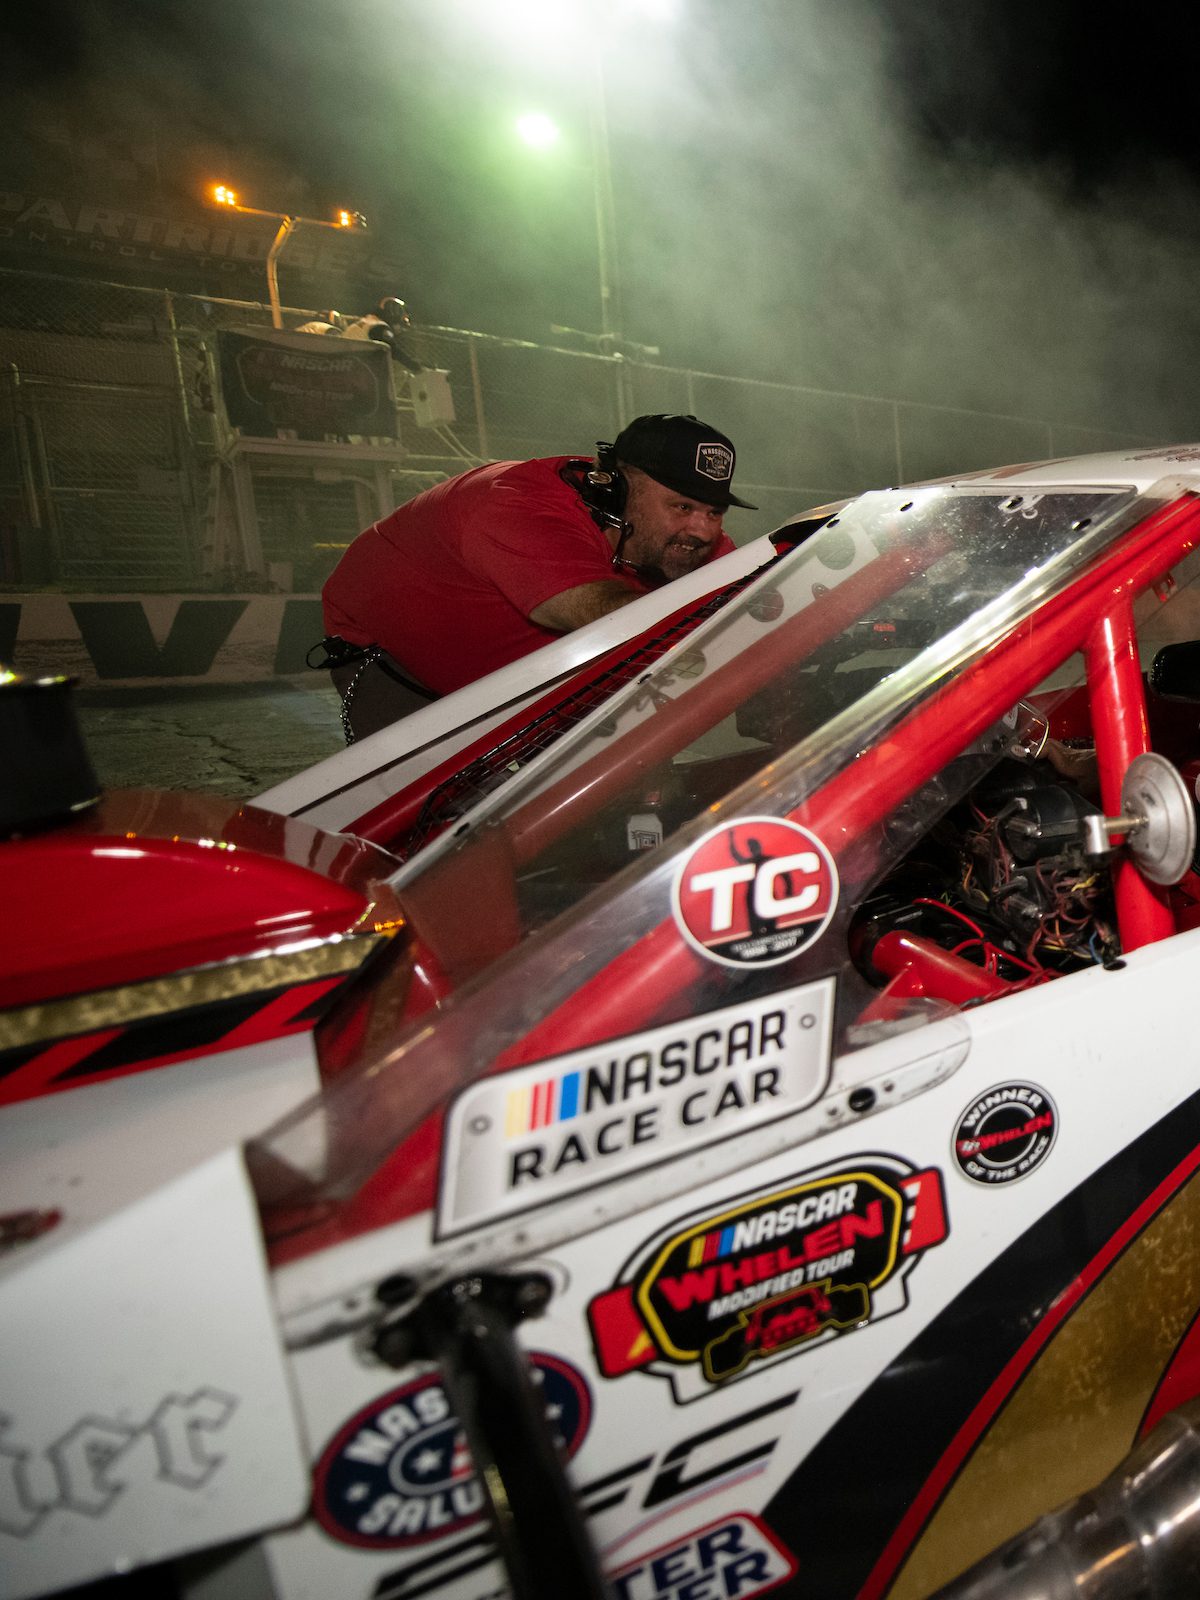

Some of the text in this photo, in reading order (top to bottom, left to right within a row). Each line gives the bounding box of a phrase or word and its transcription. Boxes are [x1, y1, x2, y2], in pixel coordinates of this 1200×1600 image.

[690, 851, 820, 932] TC
[586, 1010, 788, 1114] NASCAR
[509, 1065, 780, 1187] RACE CAR
[962, 1088, 1043, 1128] WINNER
[980, 1110, 1053, 1151] WHELEN
[965, 1135, 1050, 1181] OF THE RACE
[658, 1199, 884, 1312] WHELEN
[732, 1182, 859, 1254] NASCAR
[707, 1247, 856, 1321] MODIFIED TOUR
[344, 1386, 451, 1467] NAS
[357, 1481, 487, 1537] SALU
[614, 1523, 745, 1600] TER
